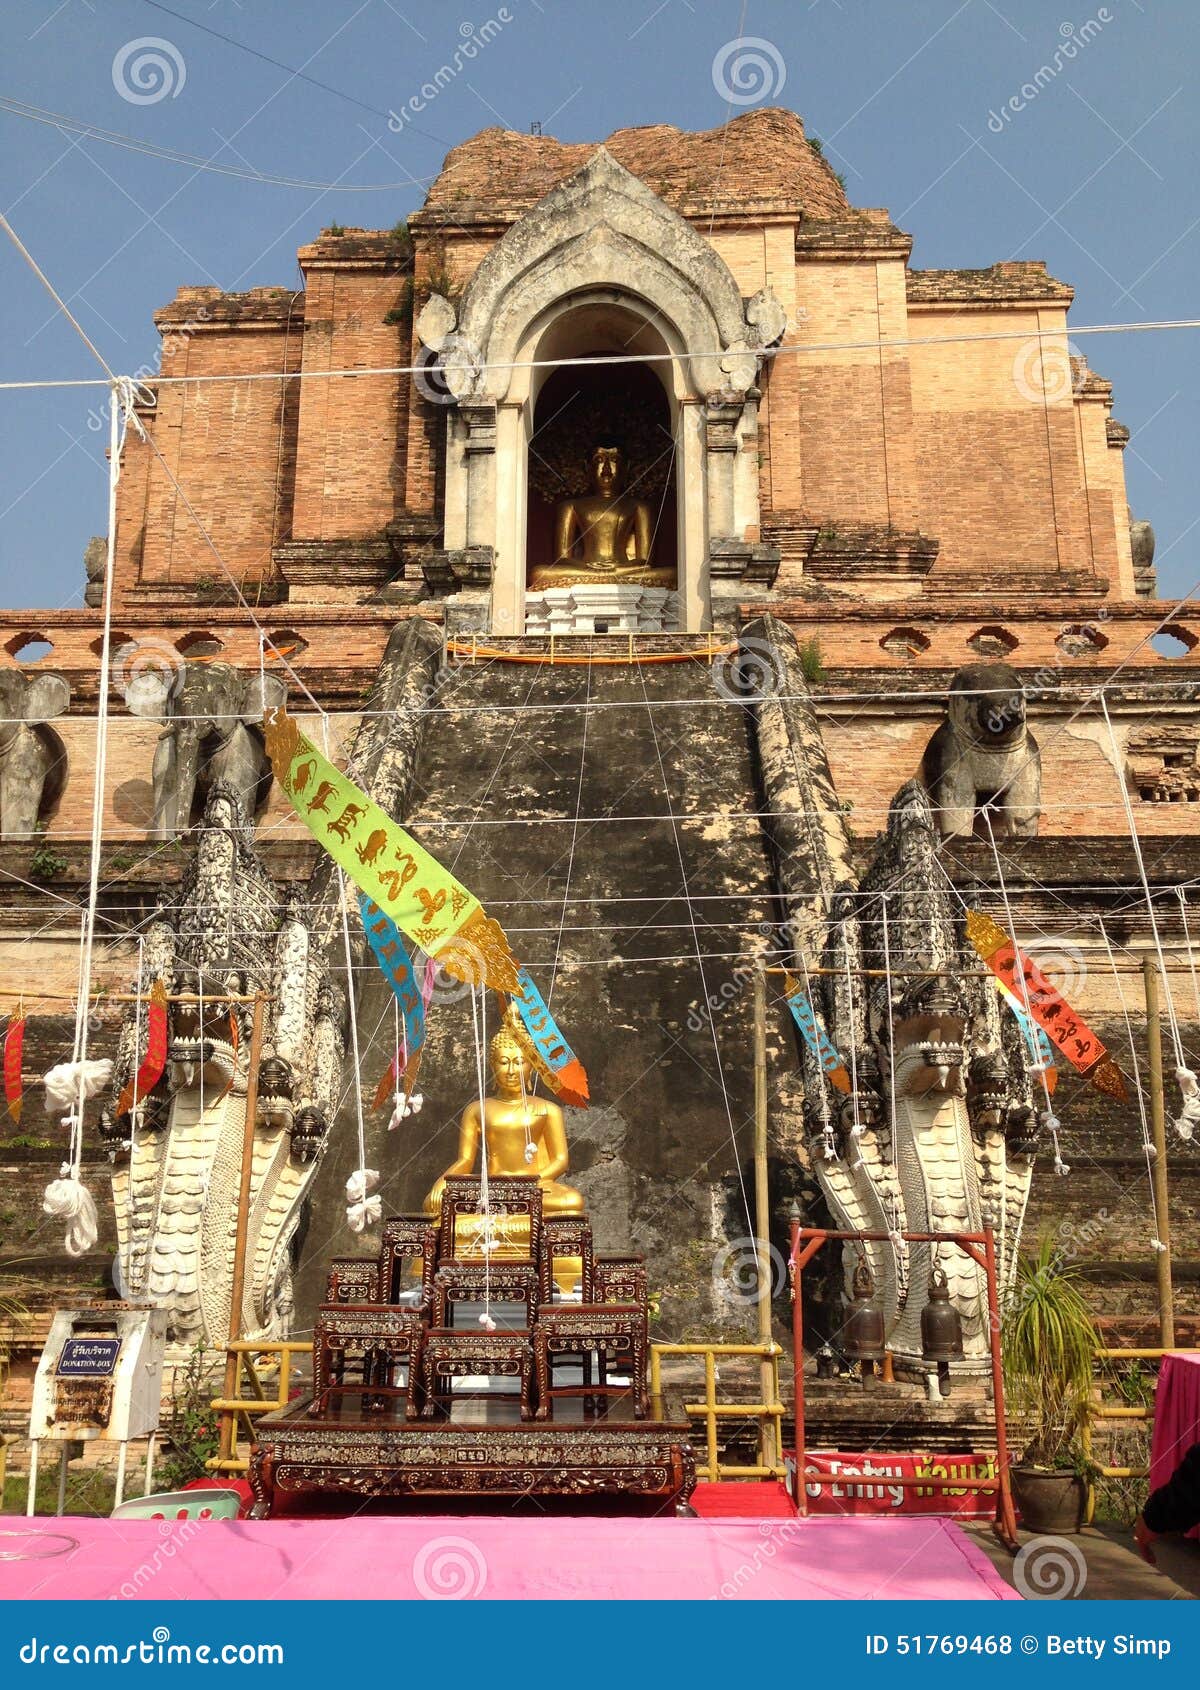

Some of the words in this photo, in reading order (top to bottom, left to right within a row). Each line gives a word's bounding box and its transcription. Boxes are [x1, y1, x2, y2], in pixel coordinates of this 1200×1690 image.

[831, 1459, 904, 1506] Entry
[915, 1455, 999, 1497] ห้ามเข้
